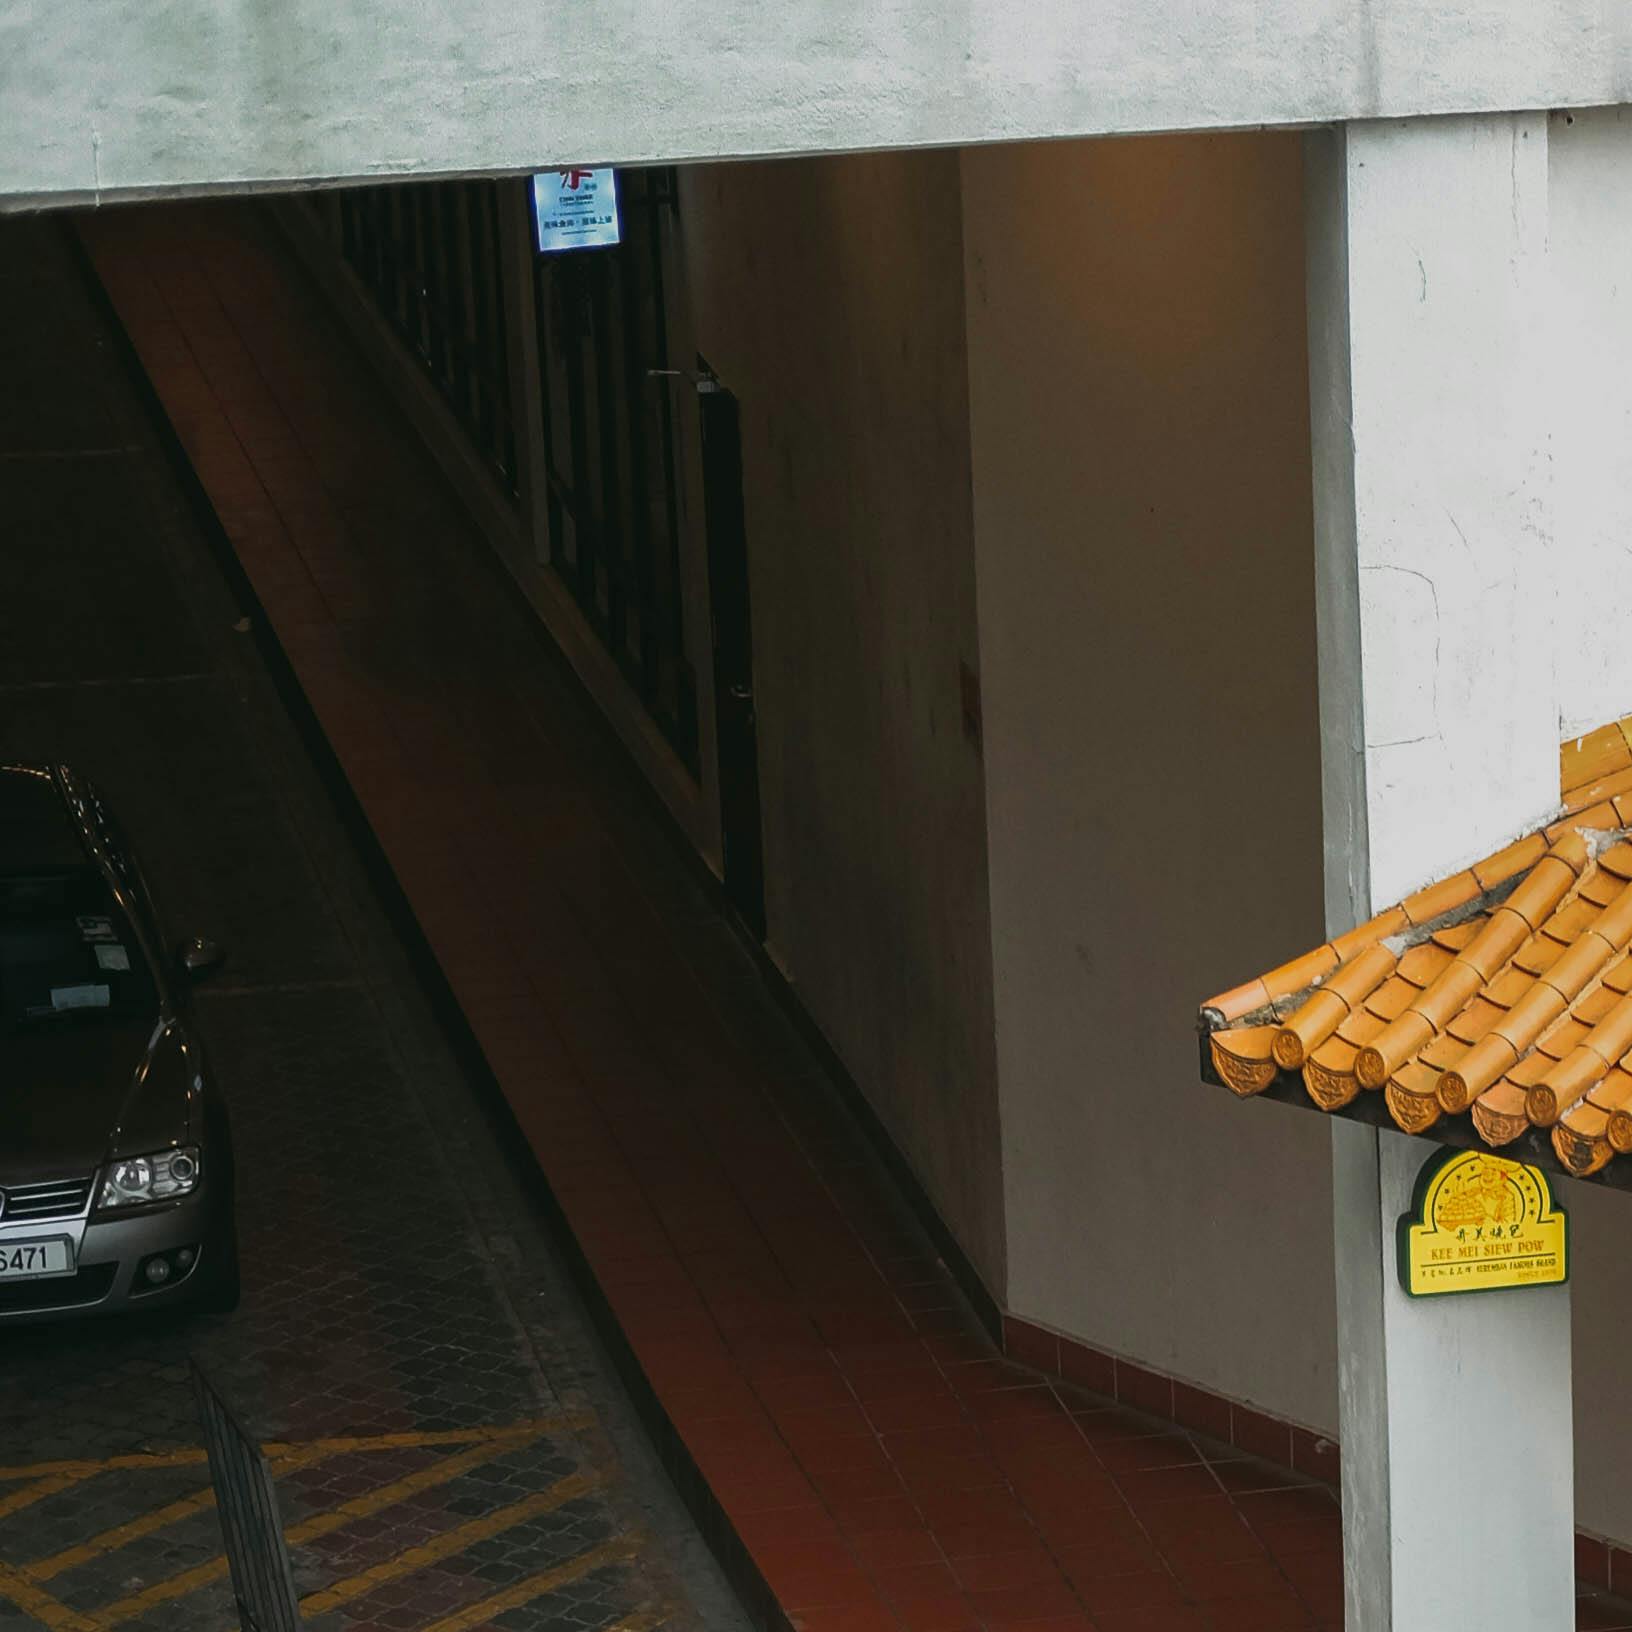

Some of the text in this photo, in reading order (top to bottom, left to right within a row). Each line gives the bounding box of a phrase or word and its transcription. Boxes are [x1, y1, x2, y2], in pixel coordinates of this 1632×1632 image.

[1431, 1240, 1545, 1261] KEE MEI SIEW POW
